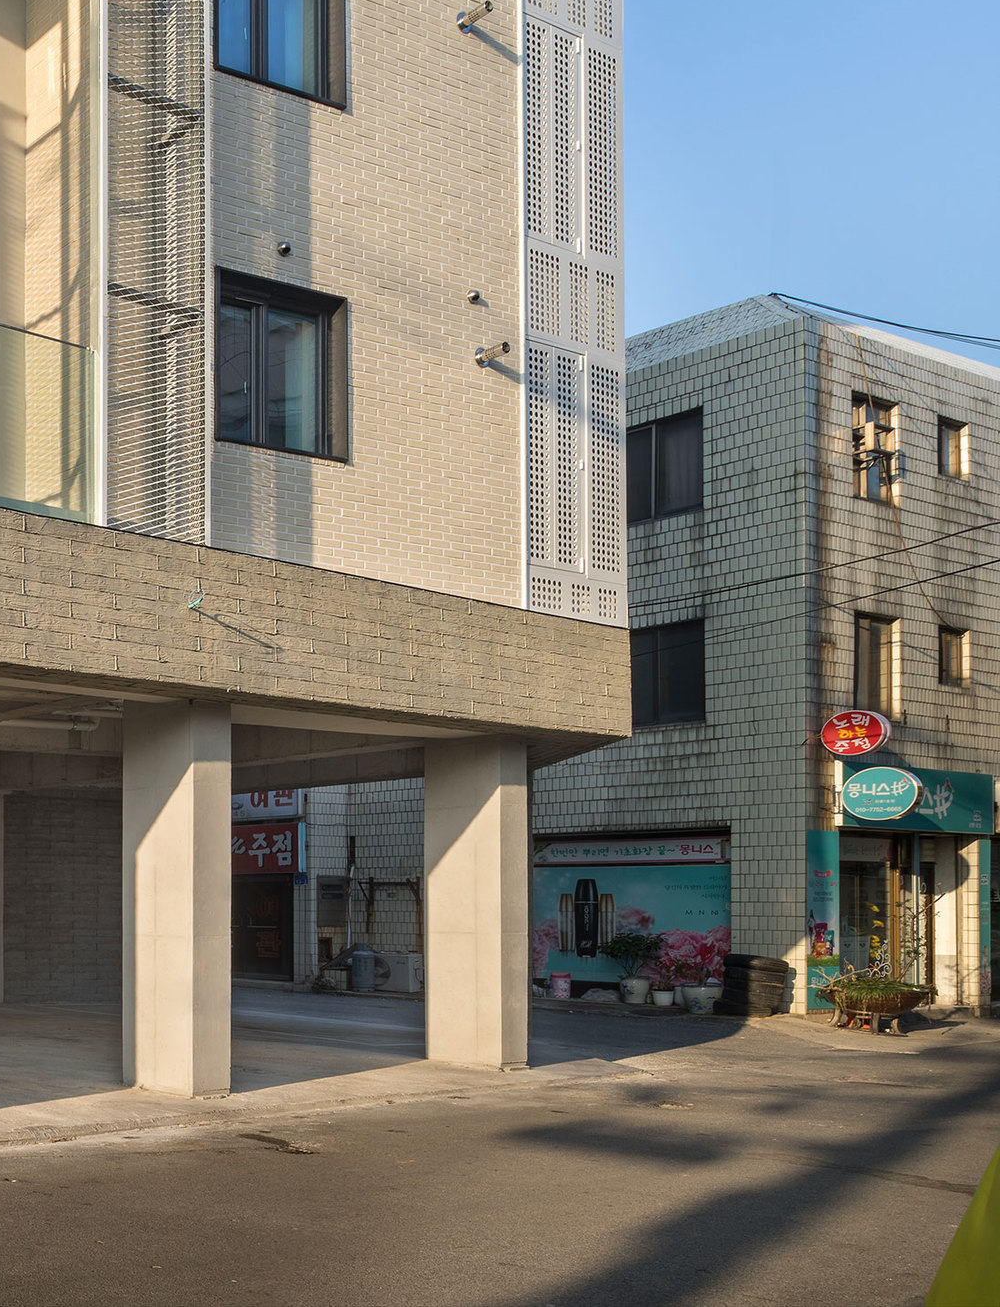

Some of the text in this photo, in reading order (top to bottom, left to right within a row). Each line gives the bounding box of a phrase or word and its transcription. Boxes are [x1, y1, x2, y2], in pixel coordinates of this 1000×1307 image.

[832, 714, 871, 729] 노래
[838, 726, 867, 739] 하는
[833, 738, 871, 753] 주점
